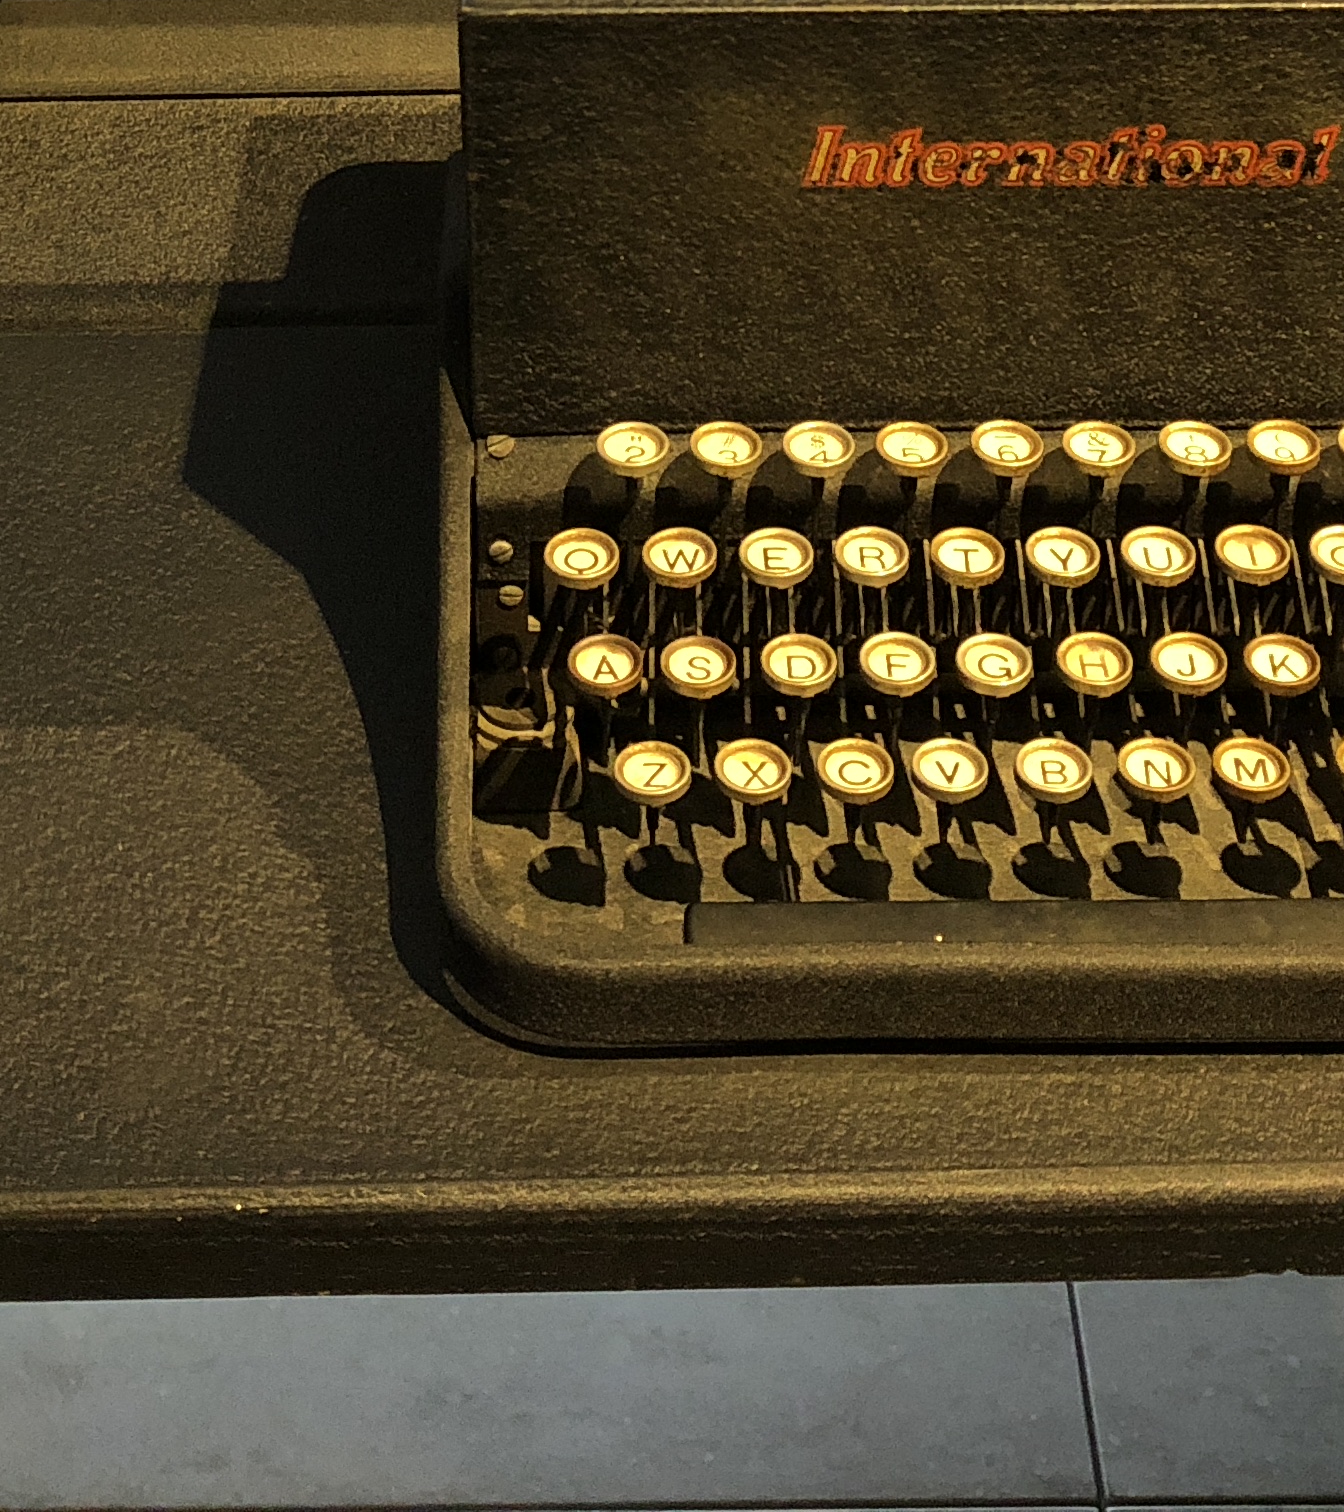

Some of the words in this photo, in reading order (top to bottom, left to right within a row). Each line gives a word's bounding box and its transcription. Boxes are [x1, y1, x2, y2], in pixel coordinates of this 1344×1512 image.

[802, 124, 1341, 188] International
[662, 548, 700, 573] W
[762, 546, 791, 571] E
[859, 546, 886, 569] R
[953, 547, 979, 573] T
[1049, 547, 1074, 572] Y
[1143, 546, 1173, 571] U
[592, 654, 619, 681] A
[685, 656, 711, 680] S
[786, 655, 817, 679] D
[886, 654, 912, 678] F
[977, 653, 1013, 681] G
[1078, 653, 1110, 678] H
[1176, 653, 1196, 677] J
[1268, 653, 1300, 679] K
[642, 762, 669, 788] Z
[741, 760, 769, 788] X
[837, 759, 873, 786] C
[934, 760, 961, 785] V
[1040, 760, 1069, 786] B
[1143, 759, 1173, 788] N
[1233, 757, 1270, 784] M
